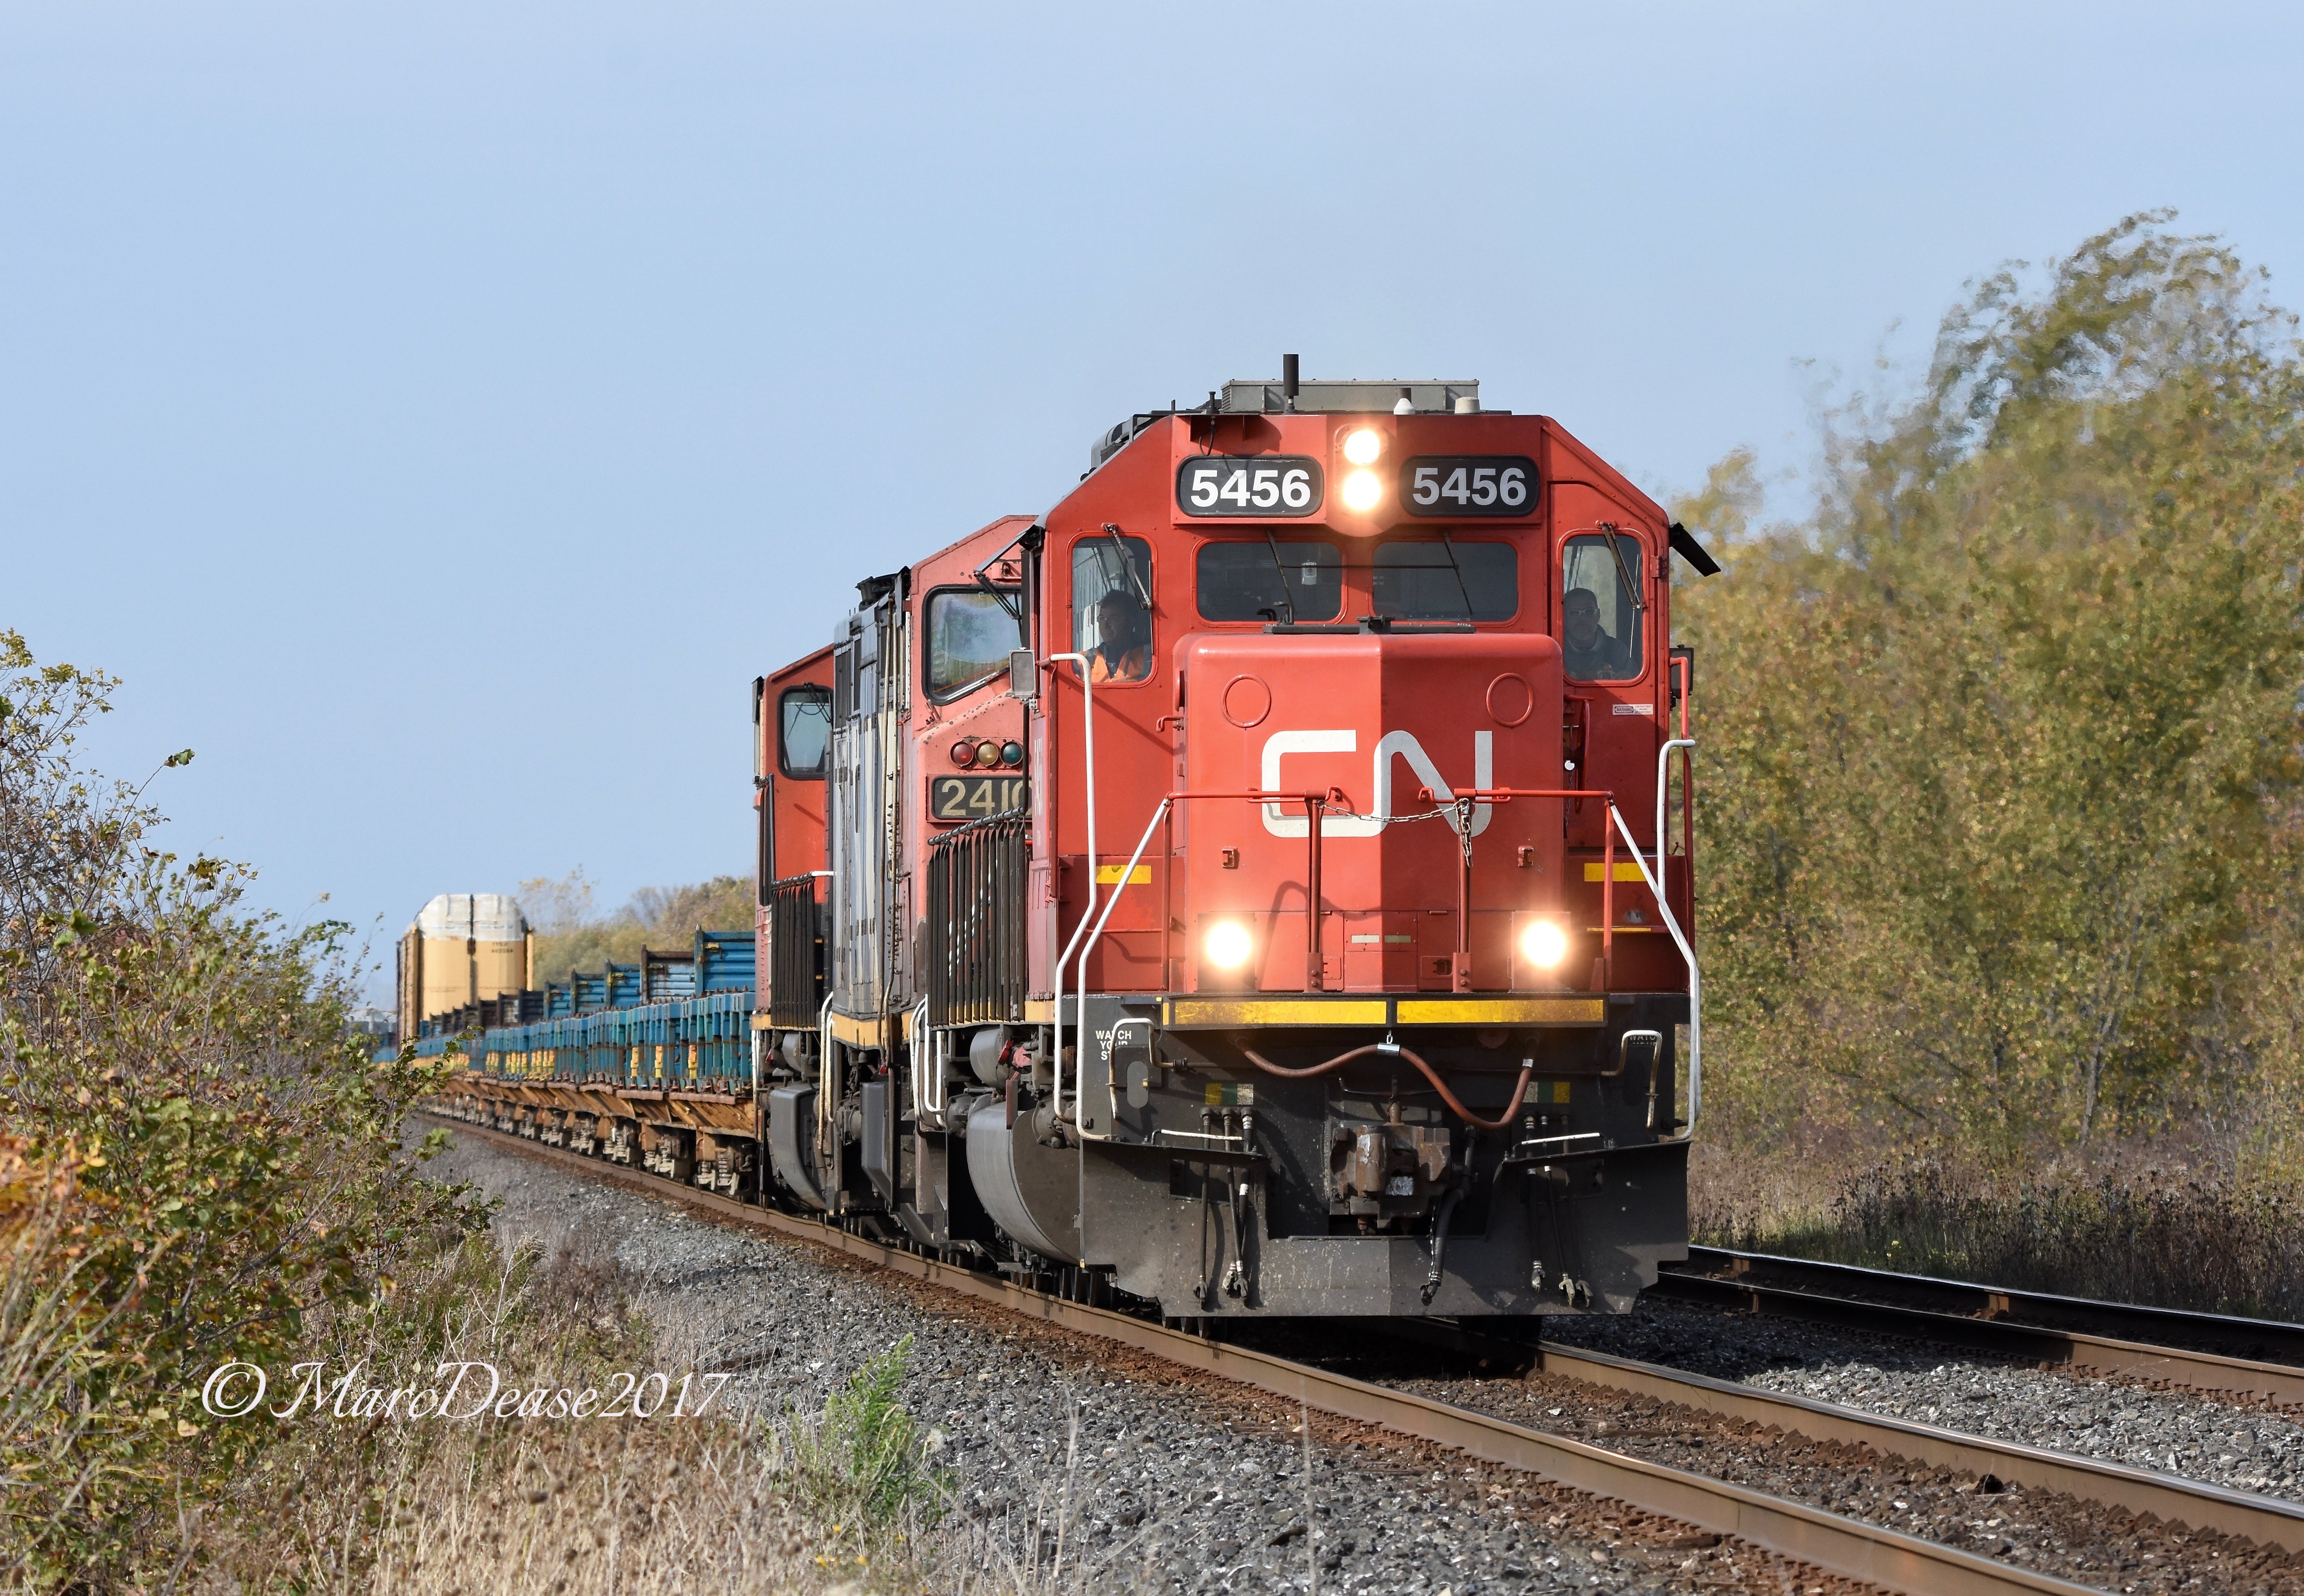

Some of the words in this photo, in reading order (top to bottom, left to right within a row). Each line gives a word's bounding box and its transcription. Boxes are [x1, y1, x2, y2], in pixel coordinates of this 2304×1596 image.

[1190, 469, 1311, 508] 5456
[1413, 467, 1526, 506] 5456
[1261, 730, 1493, 838] CN
[1095, 1030, 1132, 1040] WACH
